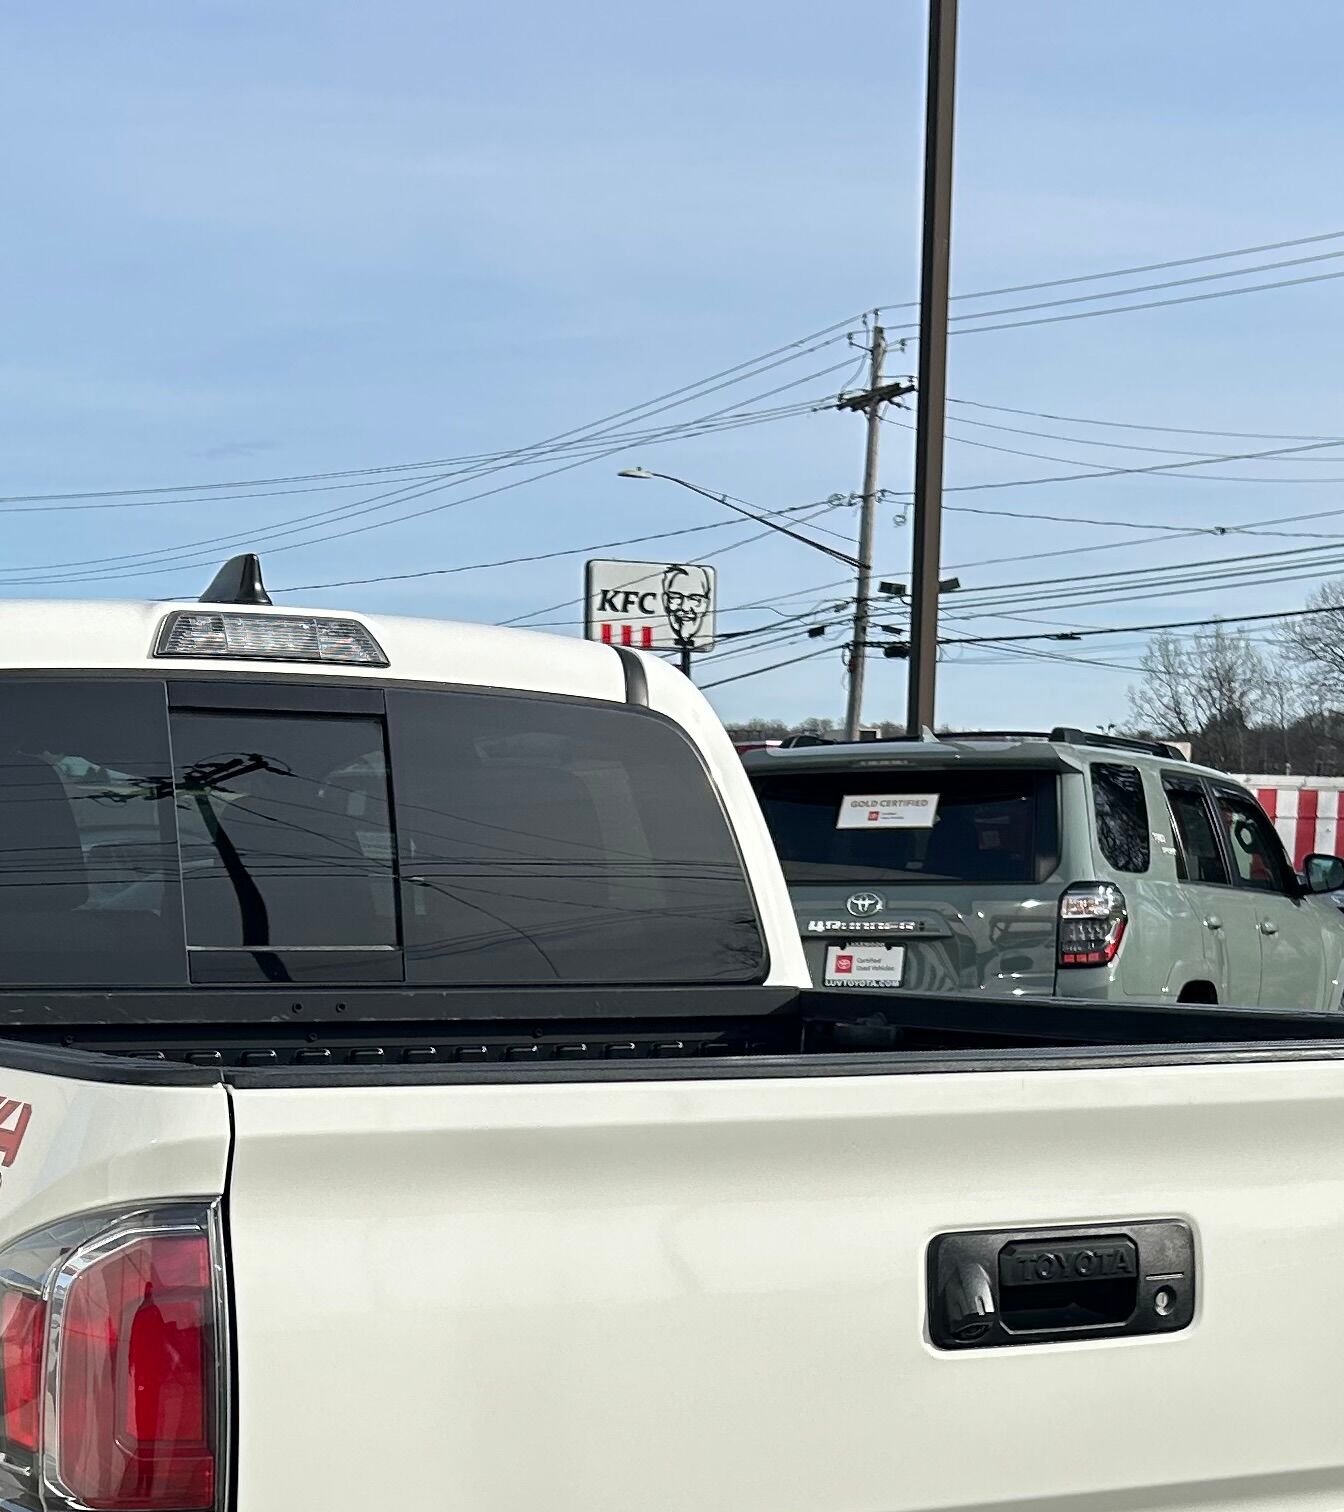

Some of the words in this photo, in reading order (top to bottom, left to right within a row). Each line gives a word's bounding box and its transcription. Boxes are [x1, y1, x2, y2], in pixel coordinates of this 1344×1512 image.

[597, 588, 657, 615] KFC
[850, 800, 878, 808] GOLD
[879, 799, 929, 808] CERTIFIED
[1016, 1249, 1135, 1281] TOYOTA
